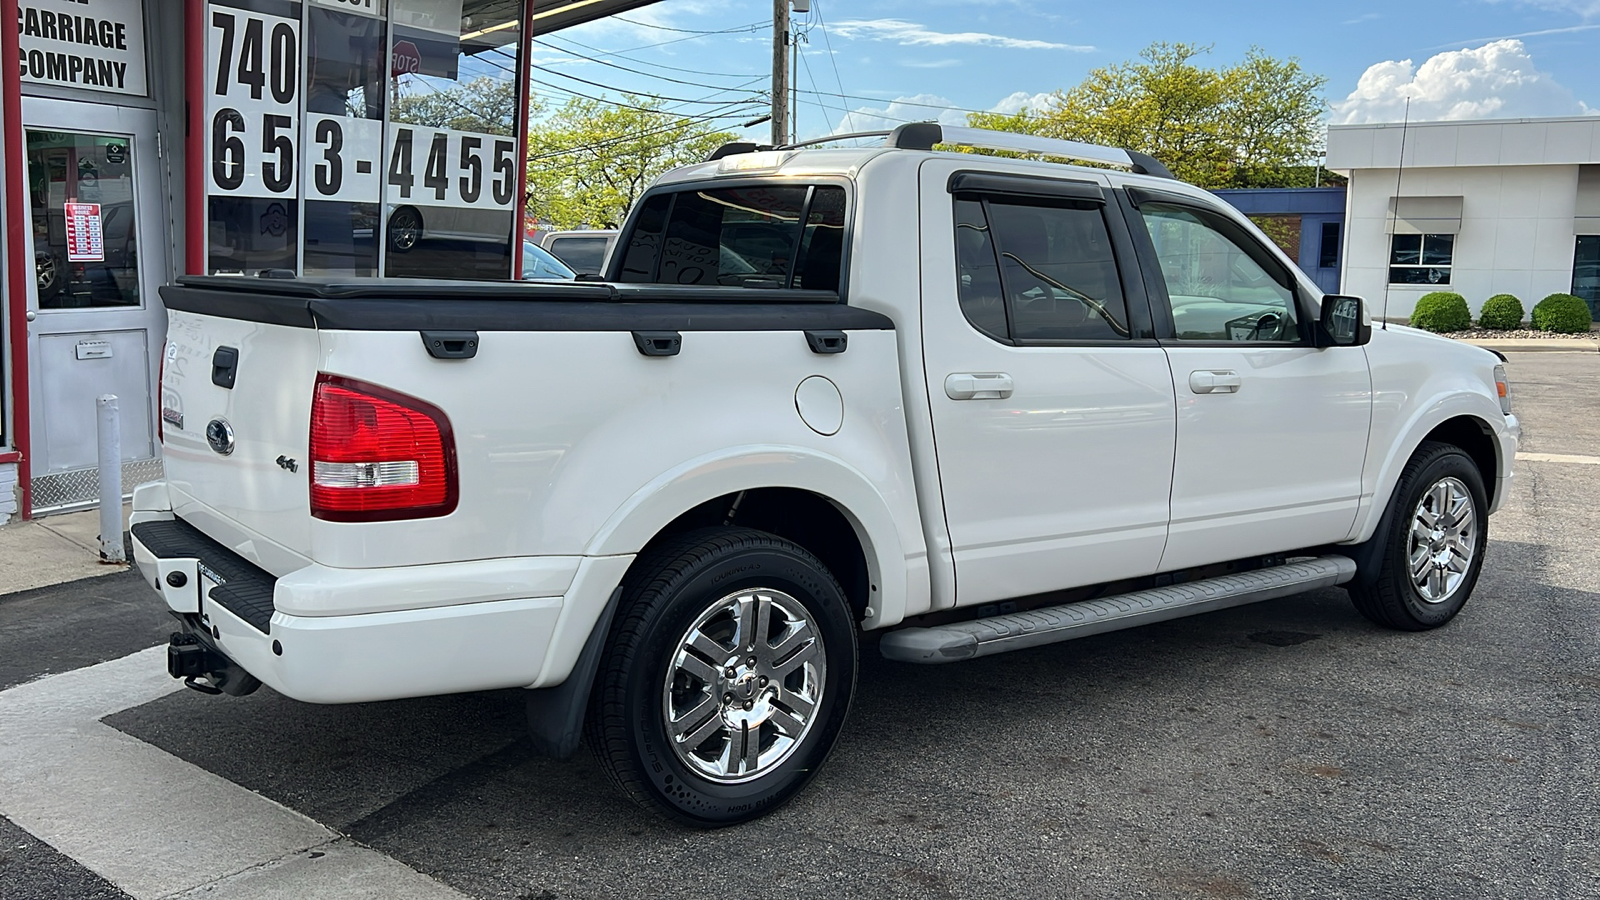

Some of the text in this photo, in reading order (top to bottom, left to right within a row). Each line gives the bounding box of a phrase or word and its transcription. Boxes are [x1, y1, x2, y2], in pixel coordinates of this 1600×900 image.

[213, 11, 296, 104] 740
[711, 565, 747, 585] TOURING
[727, 803, 752, 813] 106H
